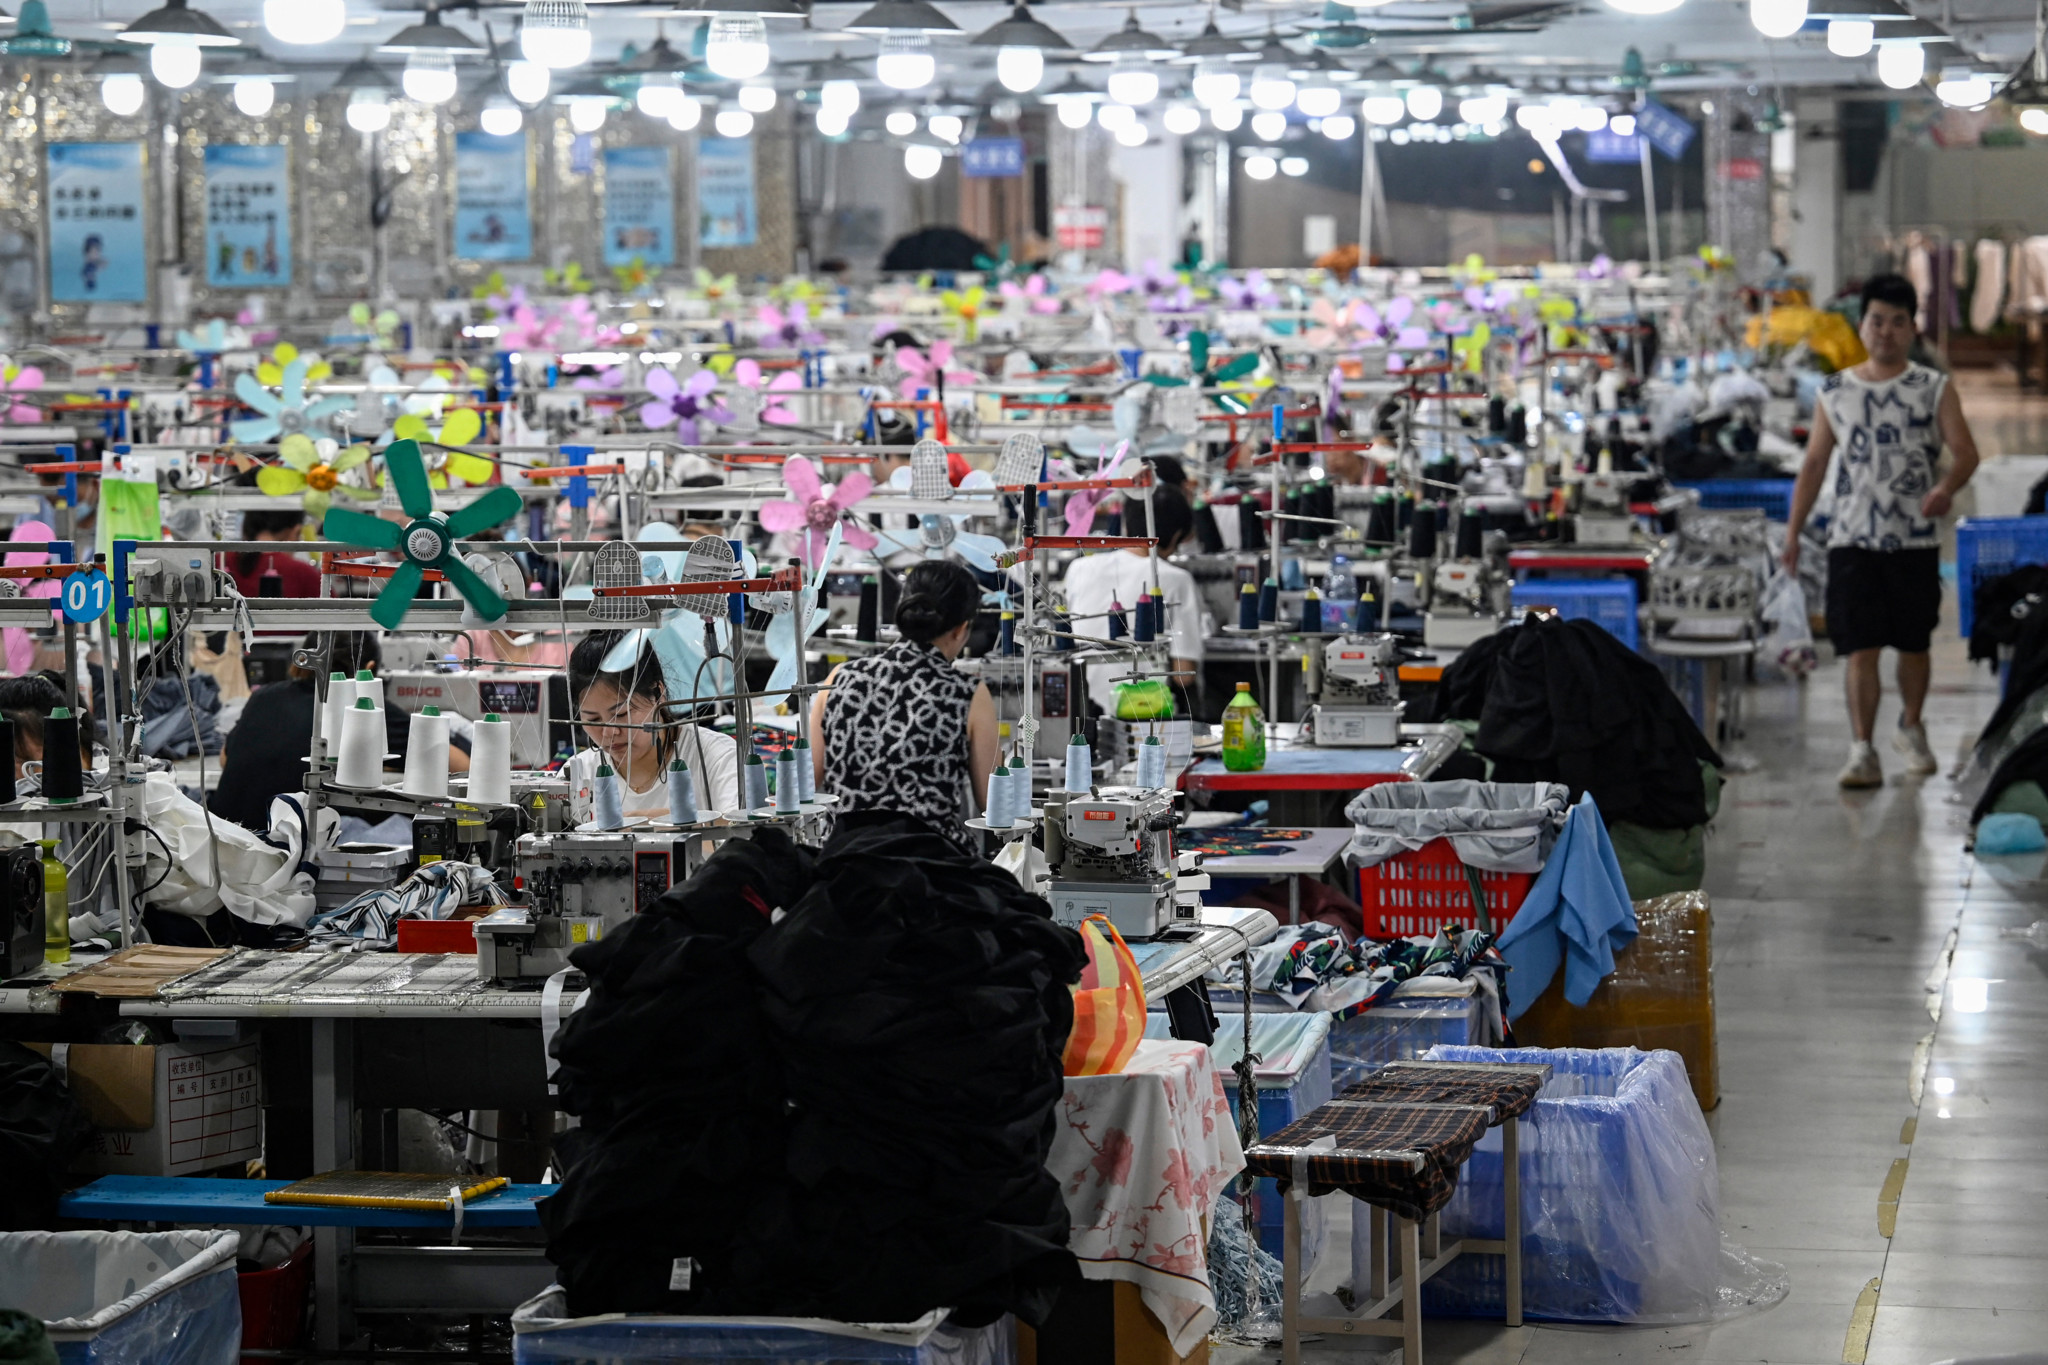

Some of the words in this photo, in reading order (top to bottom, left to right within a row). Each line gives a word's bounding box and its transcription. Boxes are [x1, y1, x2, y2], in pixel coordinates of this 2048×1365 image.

[69, 580, 104, 611] 01
[397, 686, 442, 697] BRUCE
[172, 1060, 202, 1075] 收货单位
[240, 1090, 250, 1104] 60
